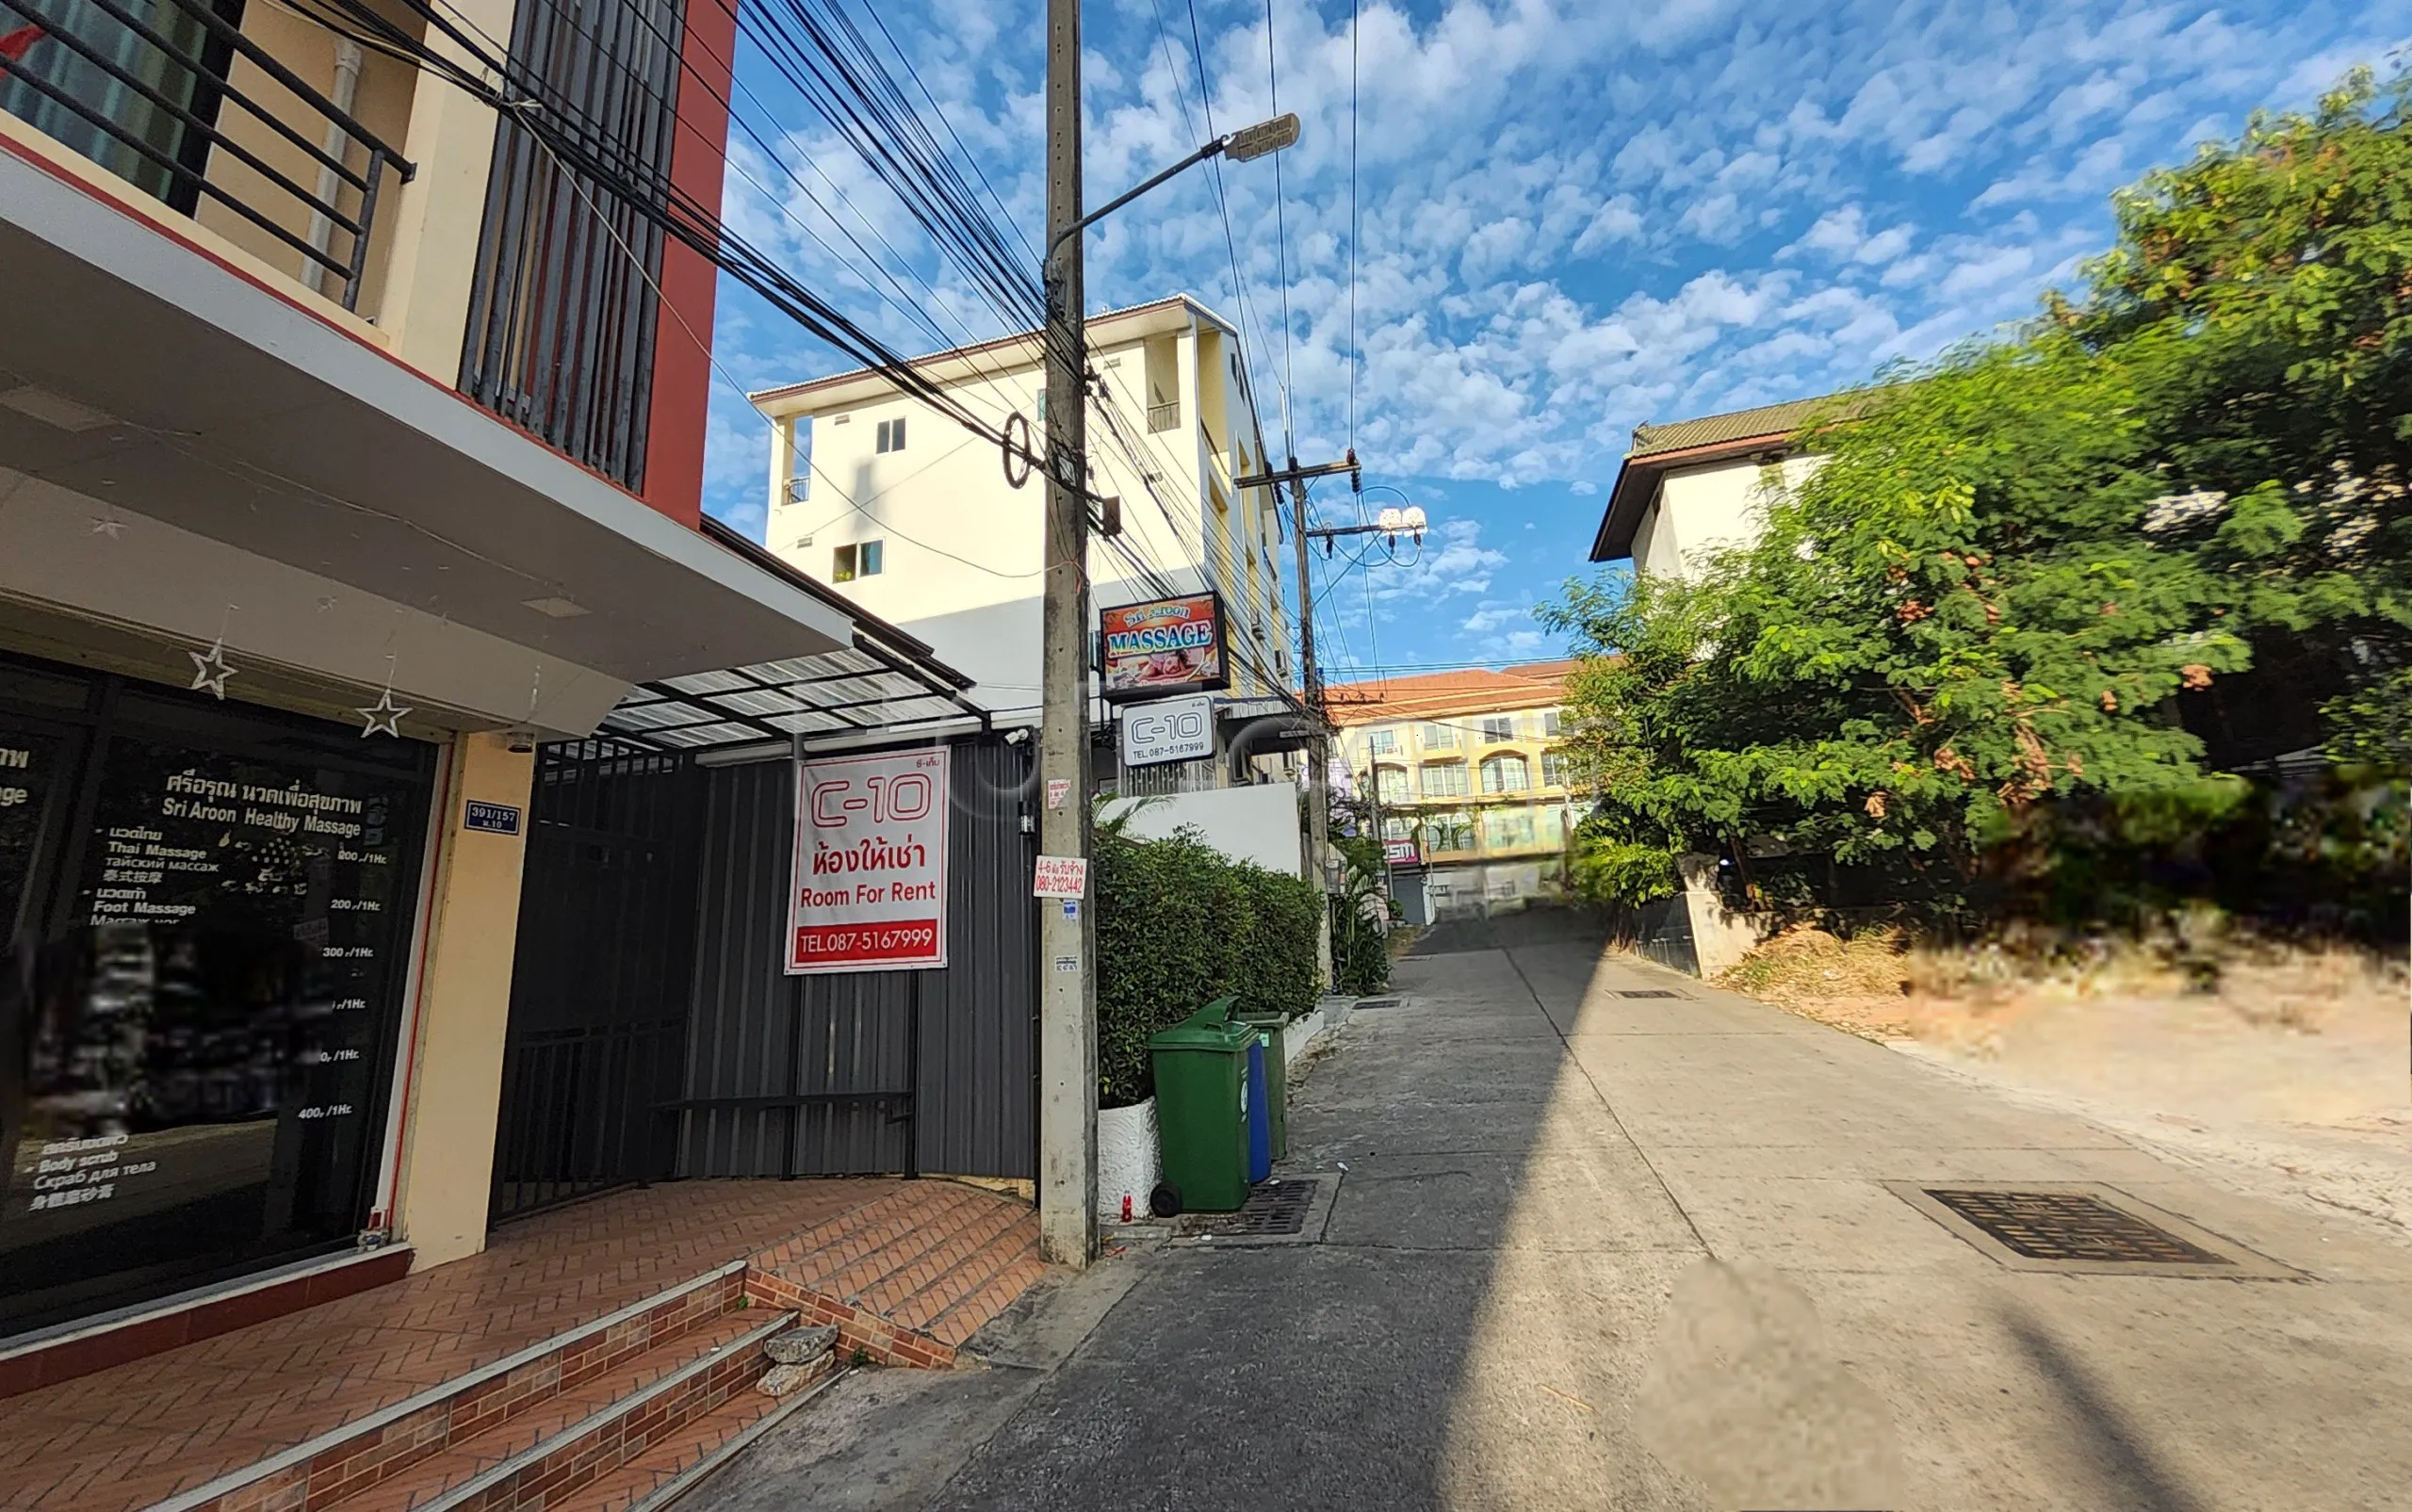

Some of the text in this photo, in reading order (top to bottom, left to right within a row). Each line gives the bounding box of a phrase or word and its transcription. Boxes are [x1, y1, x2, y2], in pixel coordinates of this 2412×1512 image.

[1109, 623, 1212, 651] MASSAGE
[1132, 712, 1203, 744] C-10
[1133, 741, 1204, 759] TEL.087-5167999
[166, 769, 363, 816] ศรีอรุณ นวดเพื่อสุขภาพ
[811, 772, 932, 828] C-10
[162, 797, 187, 818] Sri
[188, 800, 236, 823] Aroon
[244, 807, 300, 834] Healthy
[303, 813, 361, 838] Massage
[471, 807, 515, 821] 391/157
[108, 825, 163, 841] นวดไทย
[107, 841, 207, 859] Thai Massage
[813, 834, 925, 875] ห้องให้เช่า
[168, 861, 220, 872] массаж
[1060, 859, 1084, 875] รับจ้าง
[800, 881, 936, 907] Room For Rent
[92, 901, 196, 916] Foot Massage
[801, 927, 933, 953] TEL.087-5167999
[39, 1149, 120, 1174] Body scrub
[34, 1160, 156, 1191] Скраб для тела
